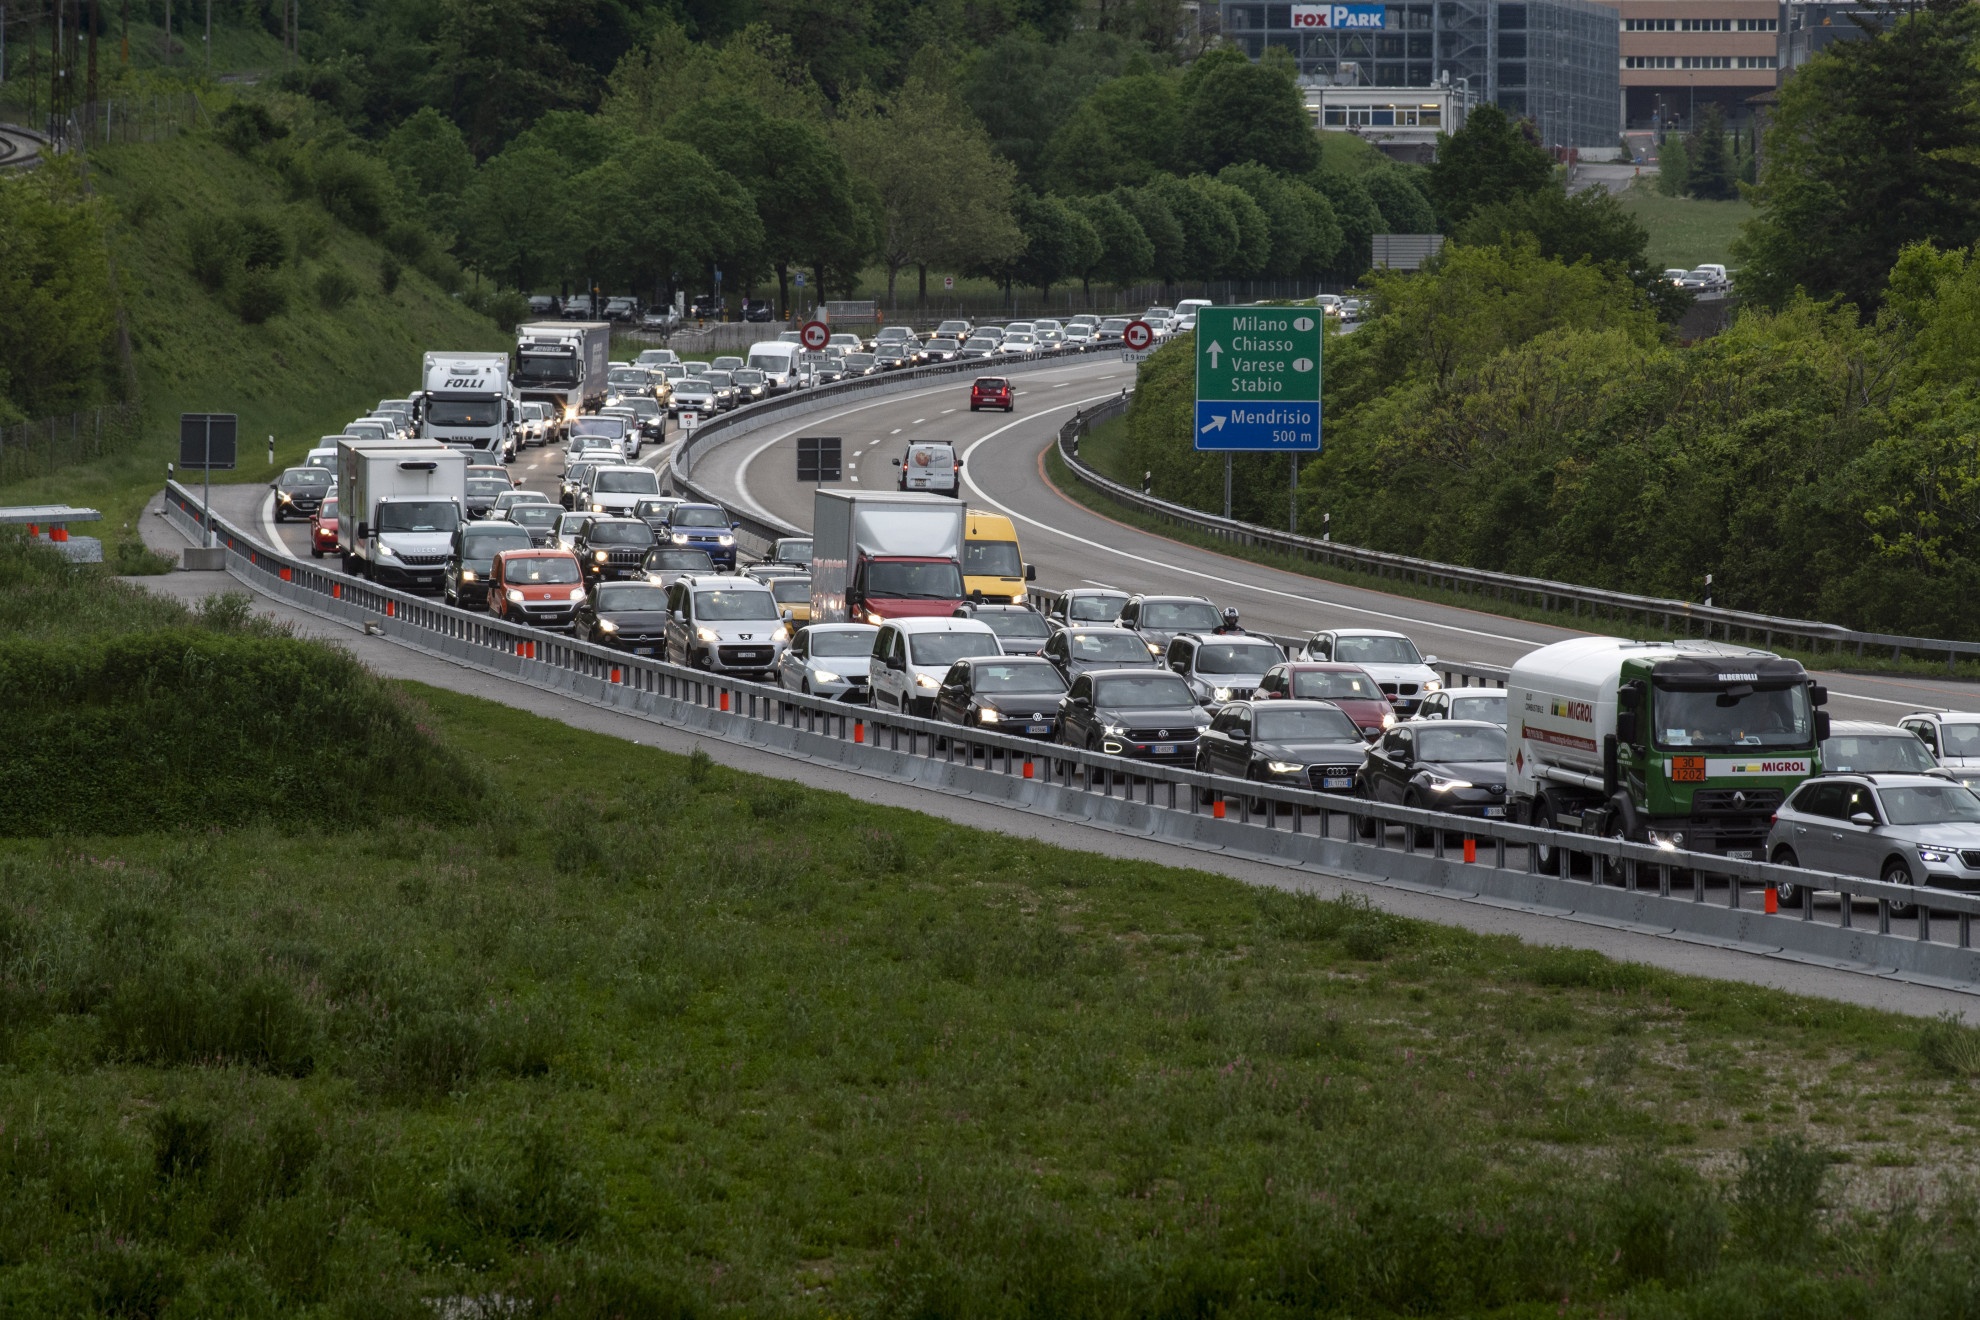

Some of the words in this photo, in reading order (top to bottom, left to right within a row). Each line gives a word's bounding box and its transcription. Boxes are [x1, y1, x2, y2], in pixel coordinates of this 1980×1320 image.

[1294, 13, 1327, 26] FOX
[1333, 6, 1382, 27] PARK
[1232, 316, 1287, 331] Milano
[1232, 336, 1293, 351] Chiasso
[1231, 357, 1285, 372] Varese
[444, 379, 485, 388] FOLLI
[1231, 377, 1282, 392] Stabio
[1231, 409, 1311, 424] Mendrisio
[1273, 431, 1296, 442] 500
[1301, 433, 1312, 442] m
[1718, 673, 1758, 681] ALBERTOLLI
[1567, 701, 1593, 723] MIGROL
[1682, 758, 1694, 768] 30
[1761, 761, 1805, 772] MIGROL
[1676, 769, 1702, 780] 1202
